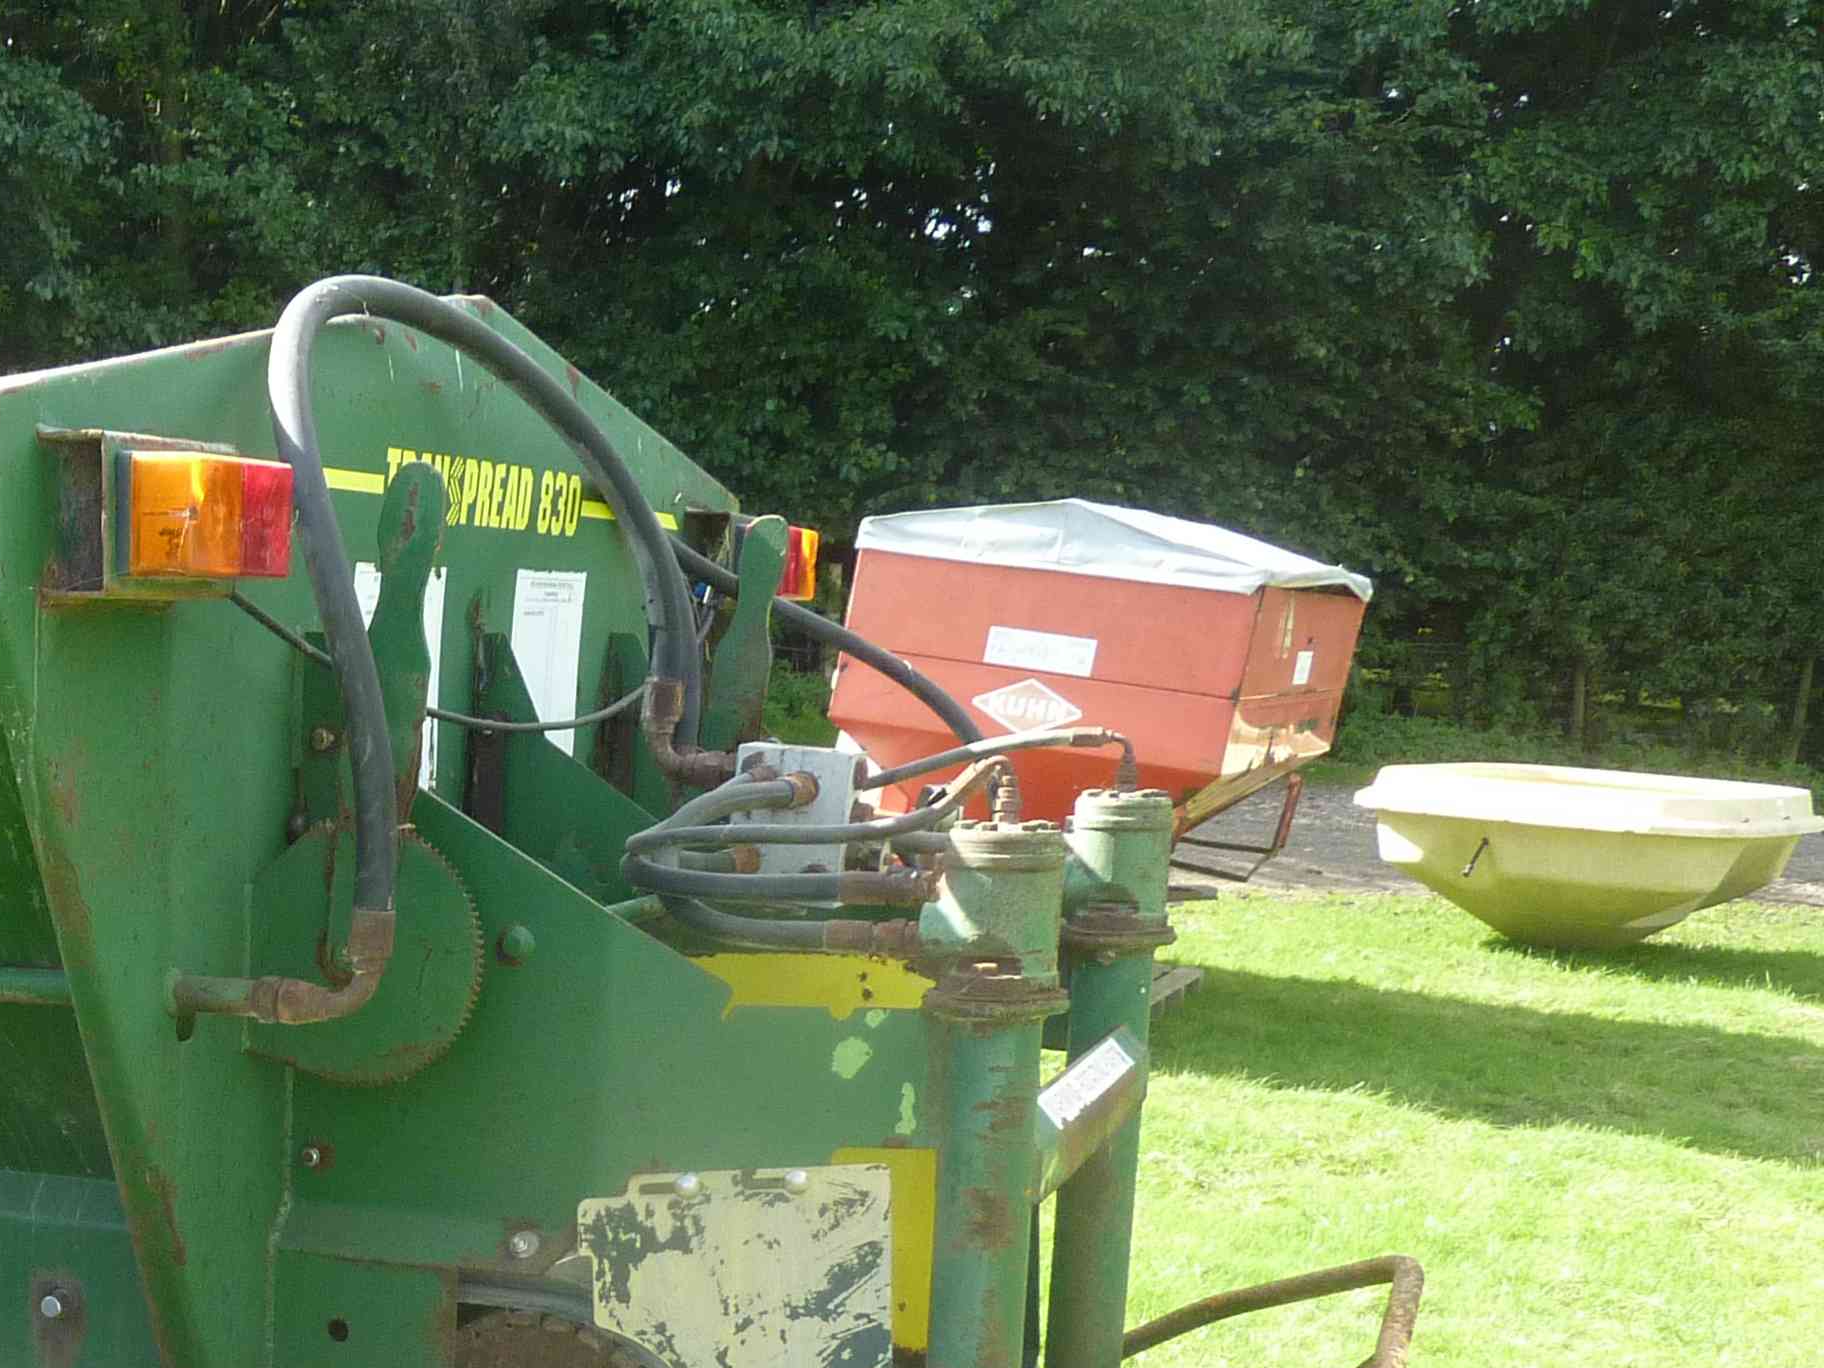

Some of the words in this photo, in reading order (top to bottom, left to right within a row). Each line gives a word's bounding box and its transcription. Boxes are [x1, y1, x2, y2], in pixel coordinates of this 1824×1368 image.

[386, 447, 533, 531] TSPREAD
[537, 469, 582, 537] 830
[990, 694, 1065, 722] KUHN
